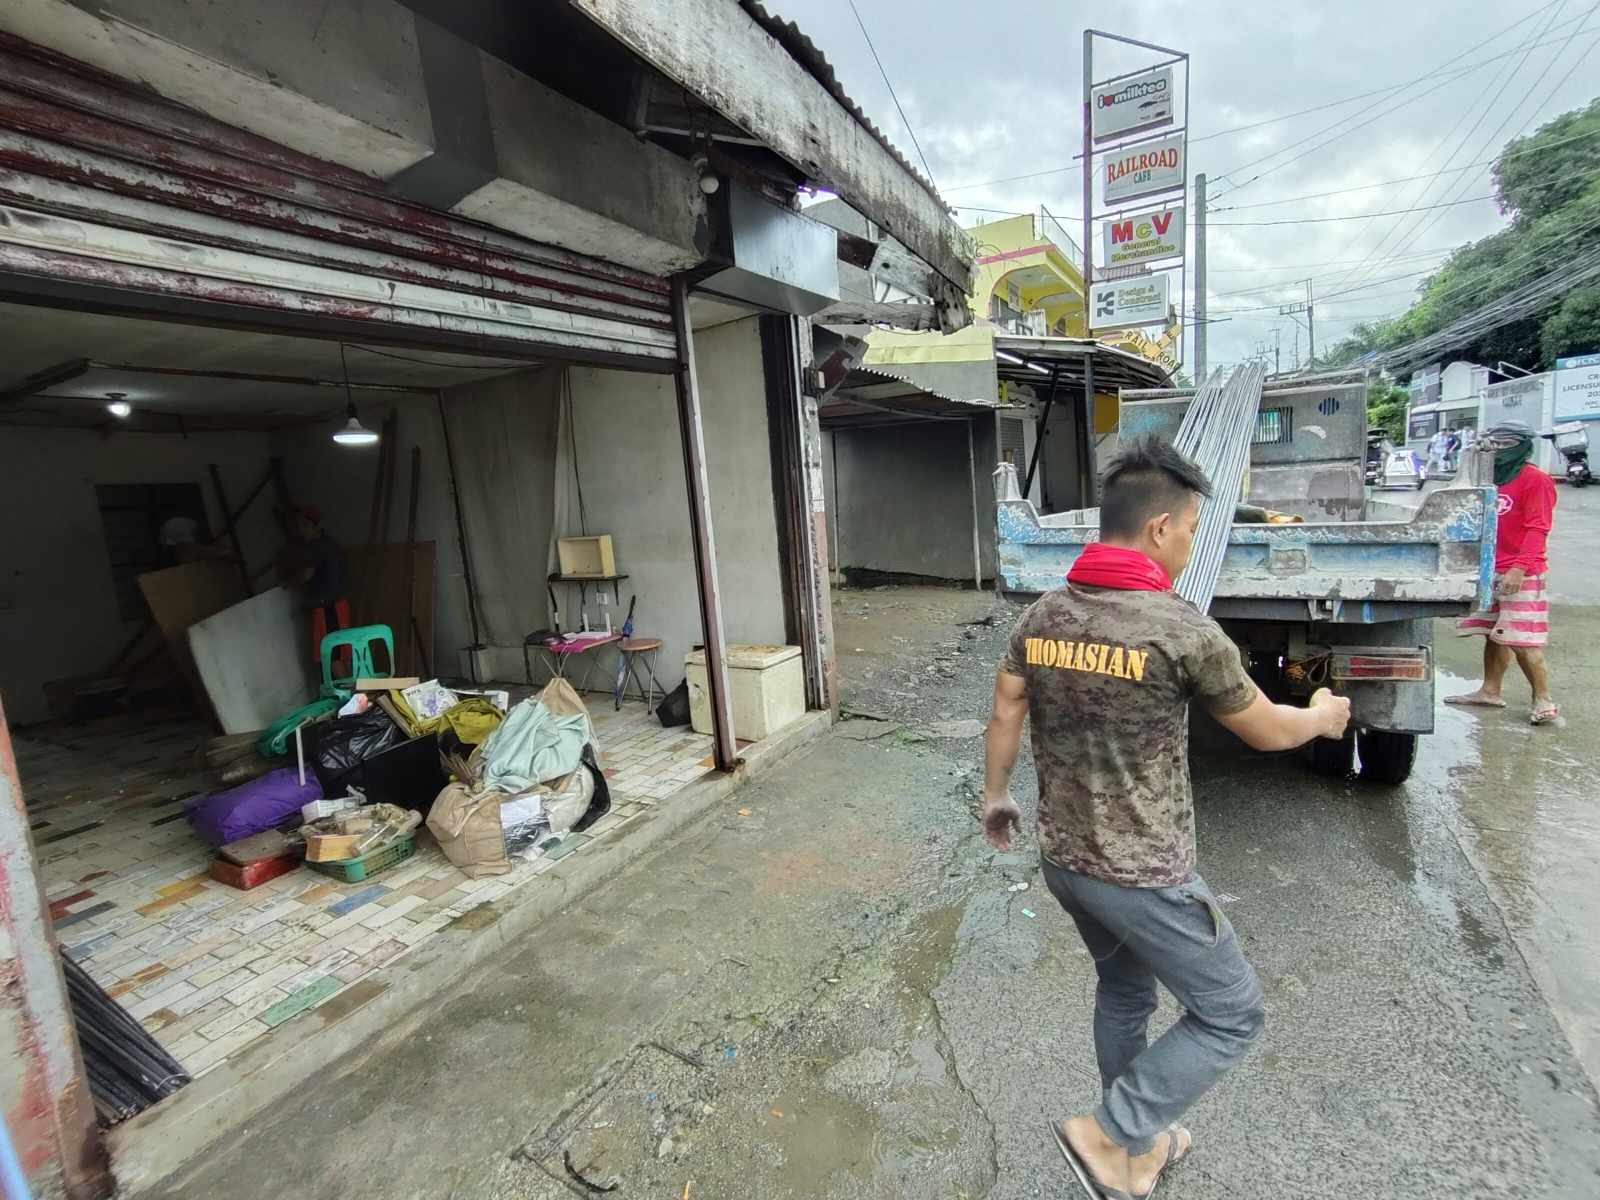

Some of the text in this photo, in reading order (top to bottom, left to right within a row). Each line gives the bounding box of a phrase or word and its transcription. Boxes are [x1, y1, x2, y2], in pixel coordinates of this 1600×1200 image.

[1113, 79, 1167, 105] milktea
[1107, 148, 1178, 184] RAILROAD
[1133, 169, 1152, 184] CAFE
